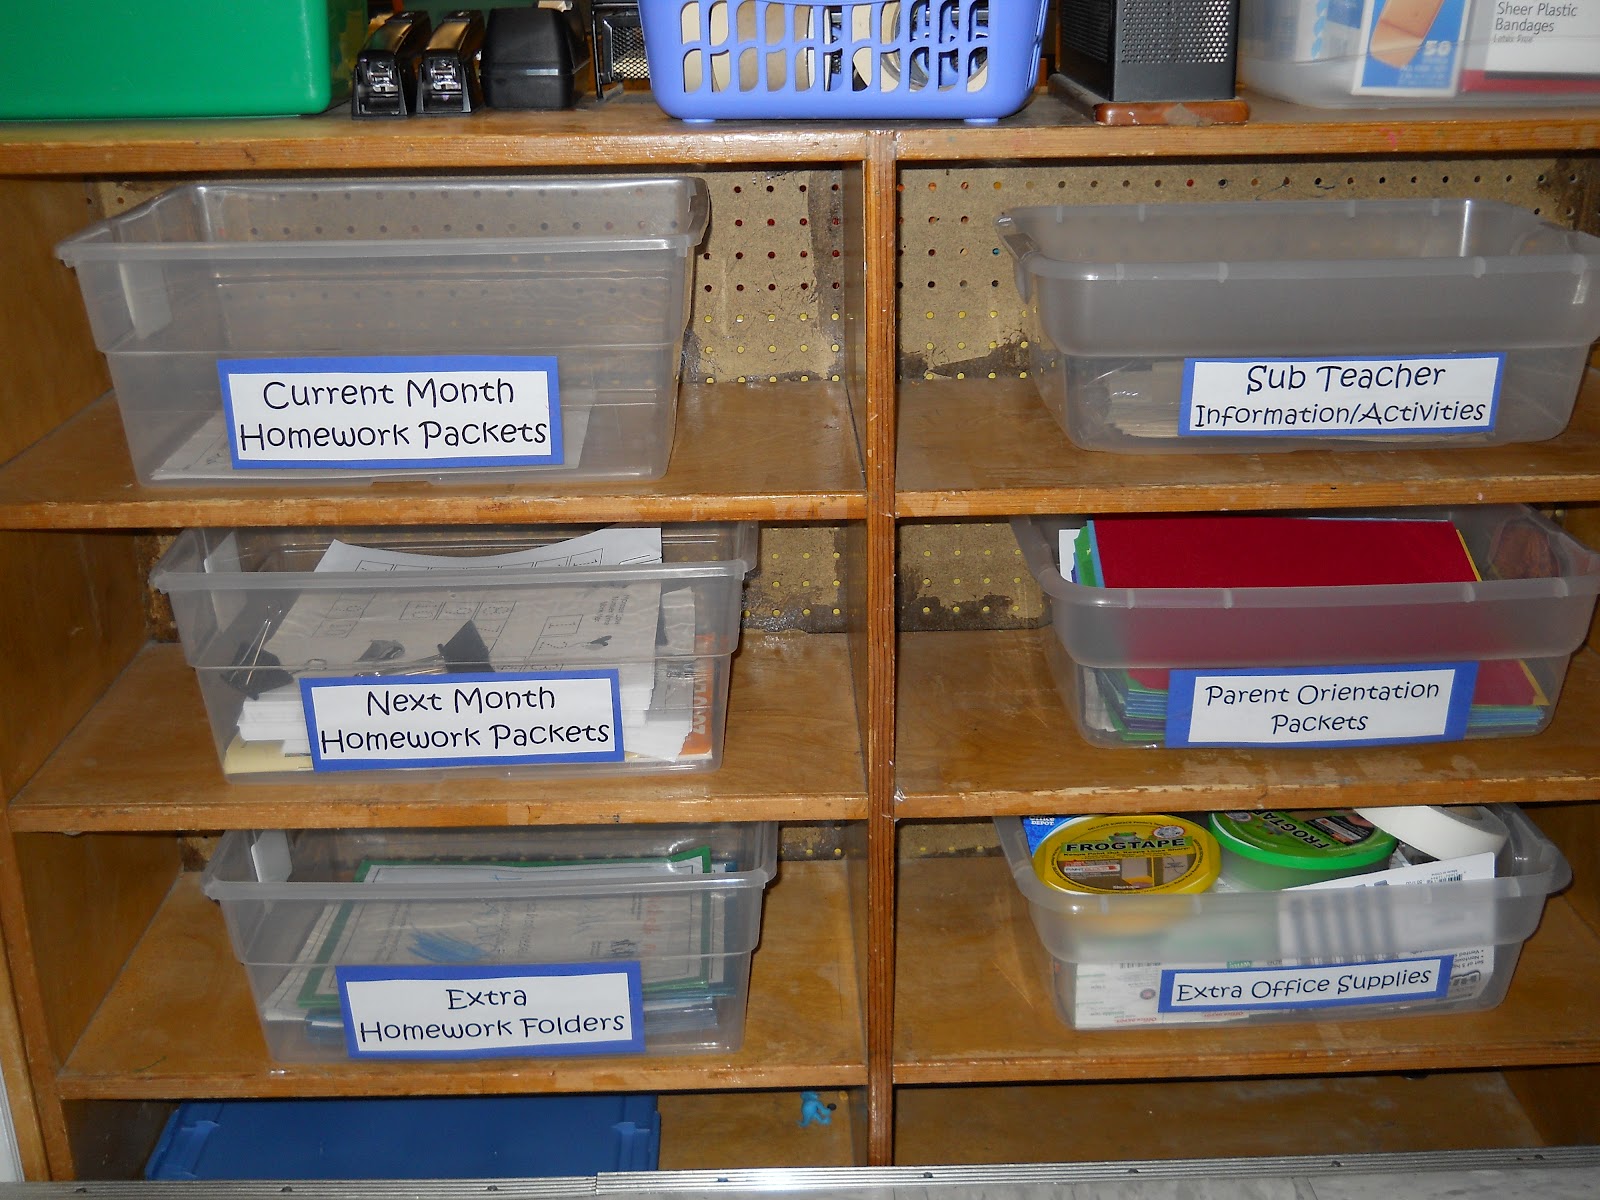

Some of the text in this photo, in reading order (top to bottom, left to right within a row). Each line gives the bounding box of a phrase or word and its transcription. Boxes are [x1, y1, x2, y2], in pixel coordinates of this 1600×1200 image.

[1497, 1, 1579, 17] Sheer Plastic
[1495, 17, 1555, 35] Bandages
[263, 378, 514, 410] Current Month
[1246, 364, 1446, 395] Sub Teacher
[1195, 401, 1486, 427] Information/Activities
[240, 421, 547, 451] Homework Packets
[367, 686, 555, 716] Next Month
[1205, 681, 1440, 706] Parent Orientation
[320, 724, 609, 753] Homework Packets
[1271, 714, 1368, 735] Packets
[1253, 810, 1331, 850] FROGTAP
[1066, 838, 1186, 852] FROGTAPE
[446, 988, 527, 1010] Extra
[1177, 984, 1242, 1001] Extra
[1252, 978, 1330, 999] Office
[1338, 969, 1432, 994] Supplies
[360, 1014, 625, 1043] Homework Folders
